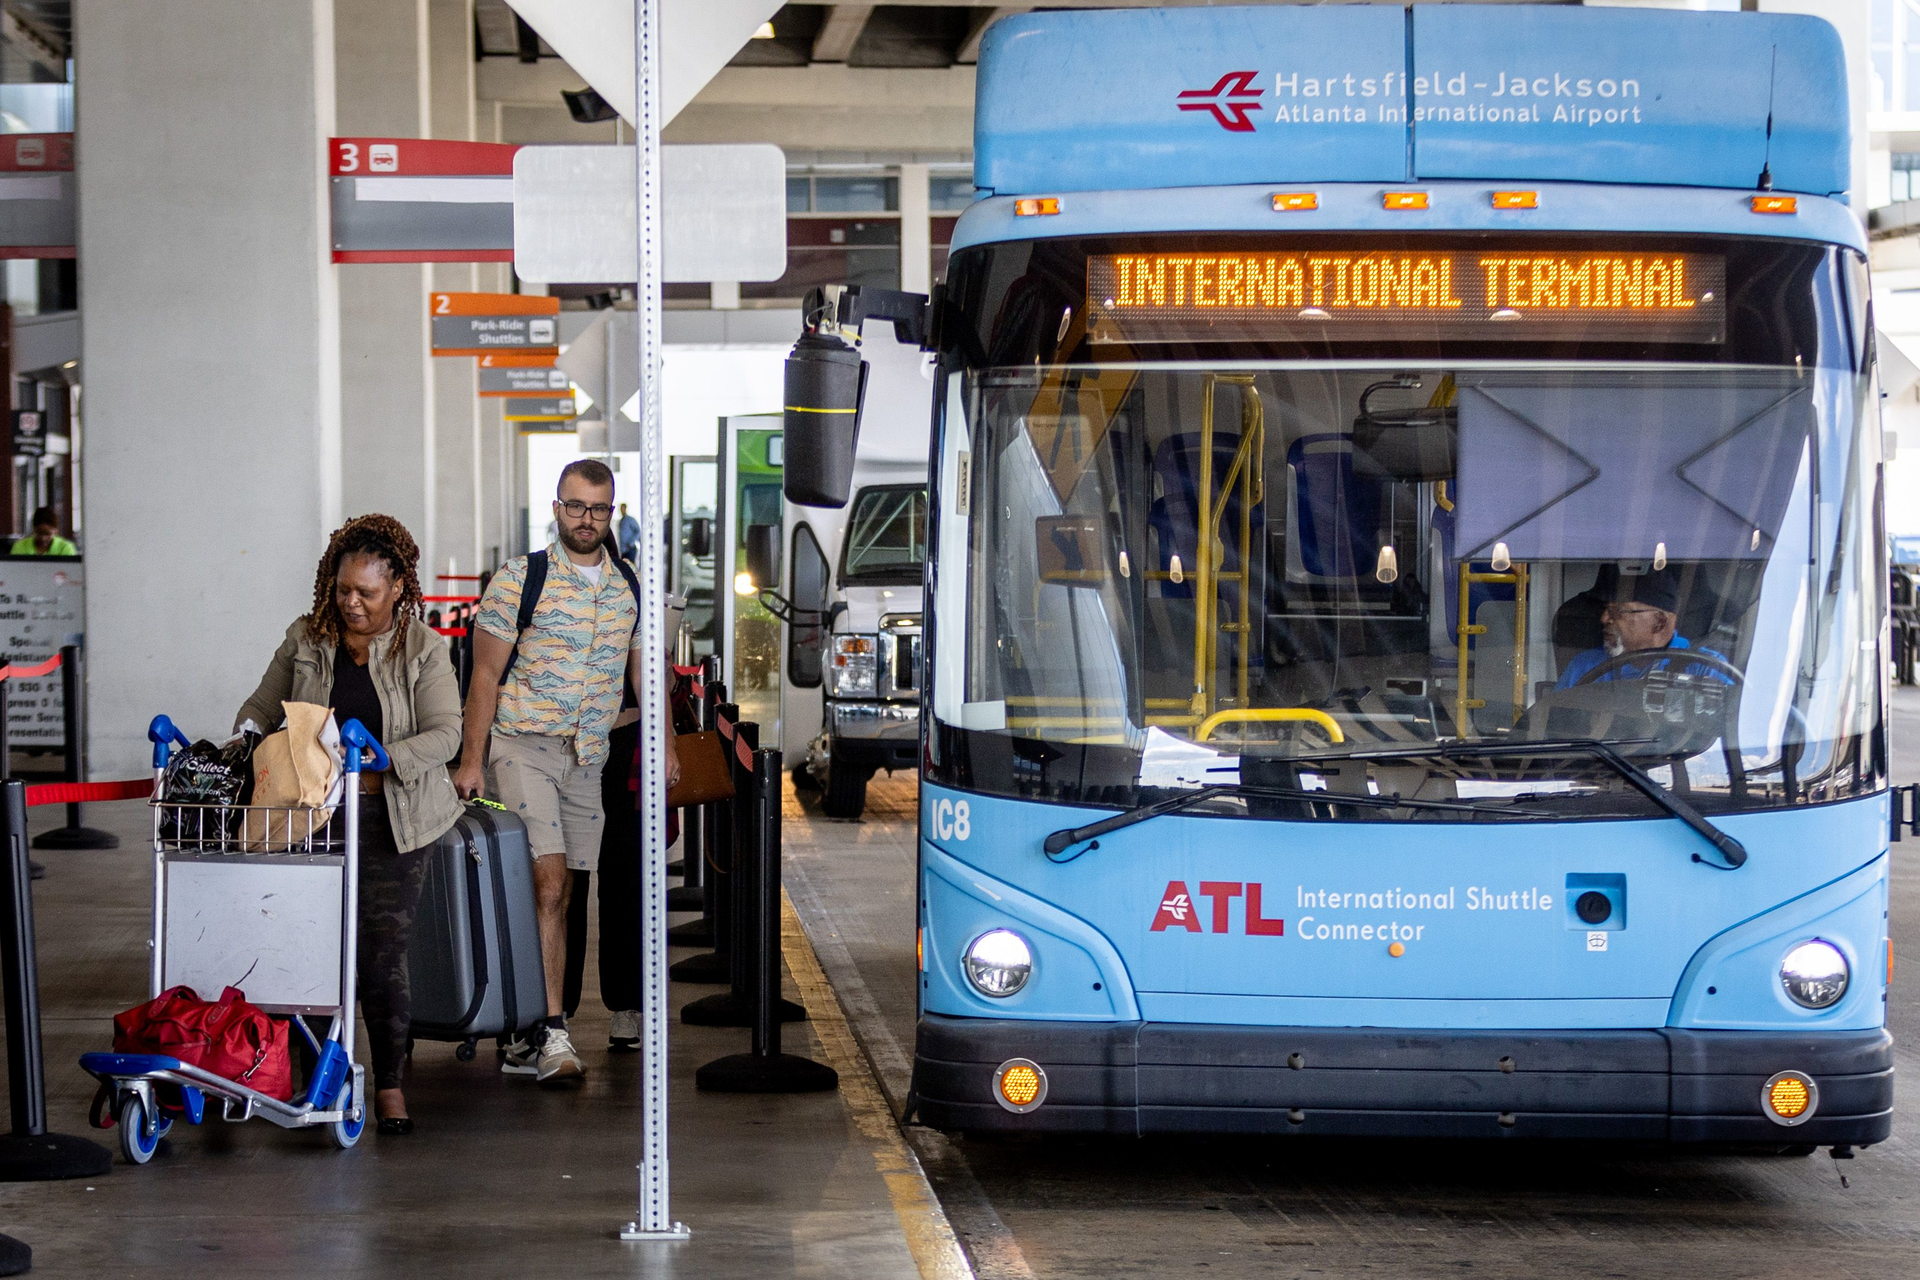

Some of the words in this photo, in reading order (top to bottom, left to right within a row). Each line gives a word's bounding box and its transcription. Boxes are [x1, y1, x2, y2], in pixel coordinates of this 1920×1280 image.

[1274, 71, 1641, 98] Hartsfield-Jackson
[1275, 104, 1367, 123] Atlanta
[1379, 103, 1541, 123] International
[1552, 103, 1642, 127] Airport
[339, 143, 359, 172] 3
[1115, 257, 1462, 307] INTERNATIONAL
[1480, 257, 1696, 308] TERMINAL
[436, 295, 450, 314] 2
[471, 320, 525, 330] Park-Ride
[479, 333, 525, 344] Shuttles
[0, 610, 25, 620] uttle
[1149, 880, 1285, 937] ATL
[1297, 886, 1455, 910] International
[1466, 887, 1553, 911] Shuttle
[1297, 916, 1425, 941] Connector
